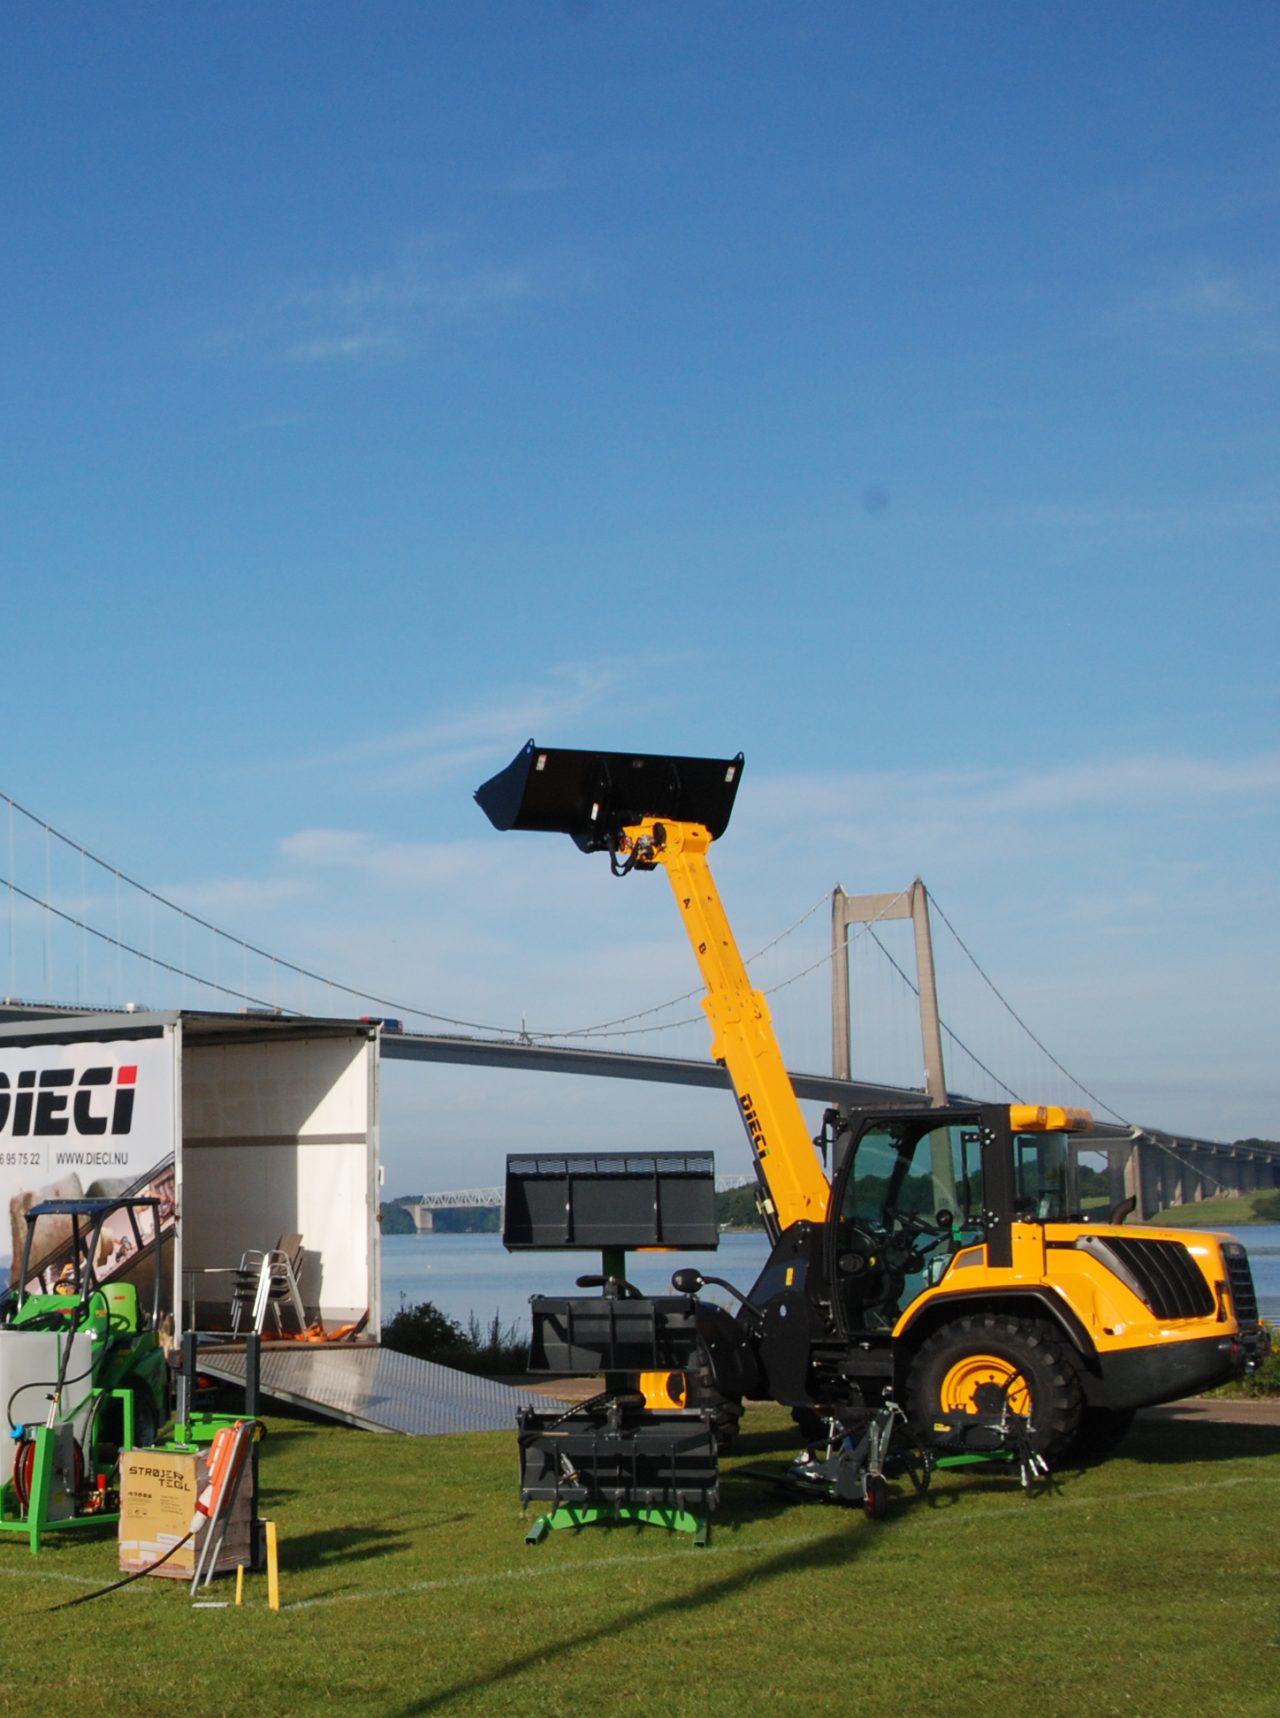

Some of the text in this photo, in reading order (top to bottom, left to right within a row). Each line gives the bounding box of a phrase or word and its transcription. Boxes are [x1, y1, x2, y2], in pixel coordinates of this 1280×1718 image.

[739, 1093, 770, 1160] DIECI
[6, 1153, 16, 1165] 95
[19, 1153, 29, 1165] 75
[30, 1153, 40, 1165] 22
[56, 1152, 129, 1166] WWW.DIECI.NU
[158, 1478, 192, 1492] TEGL
